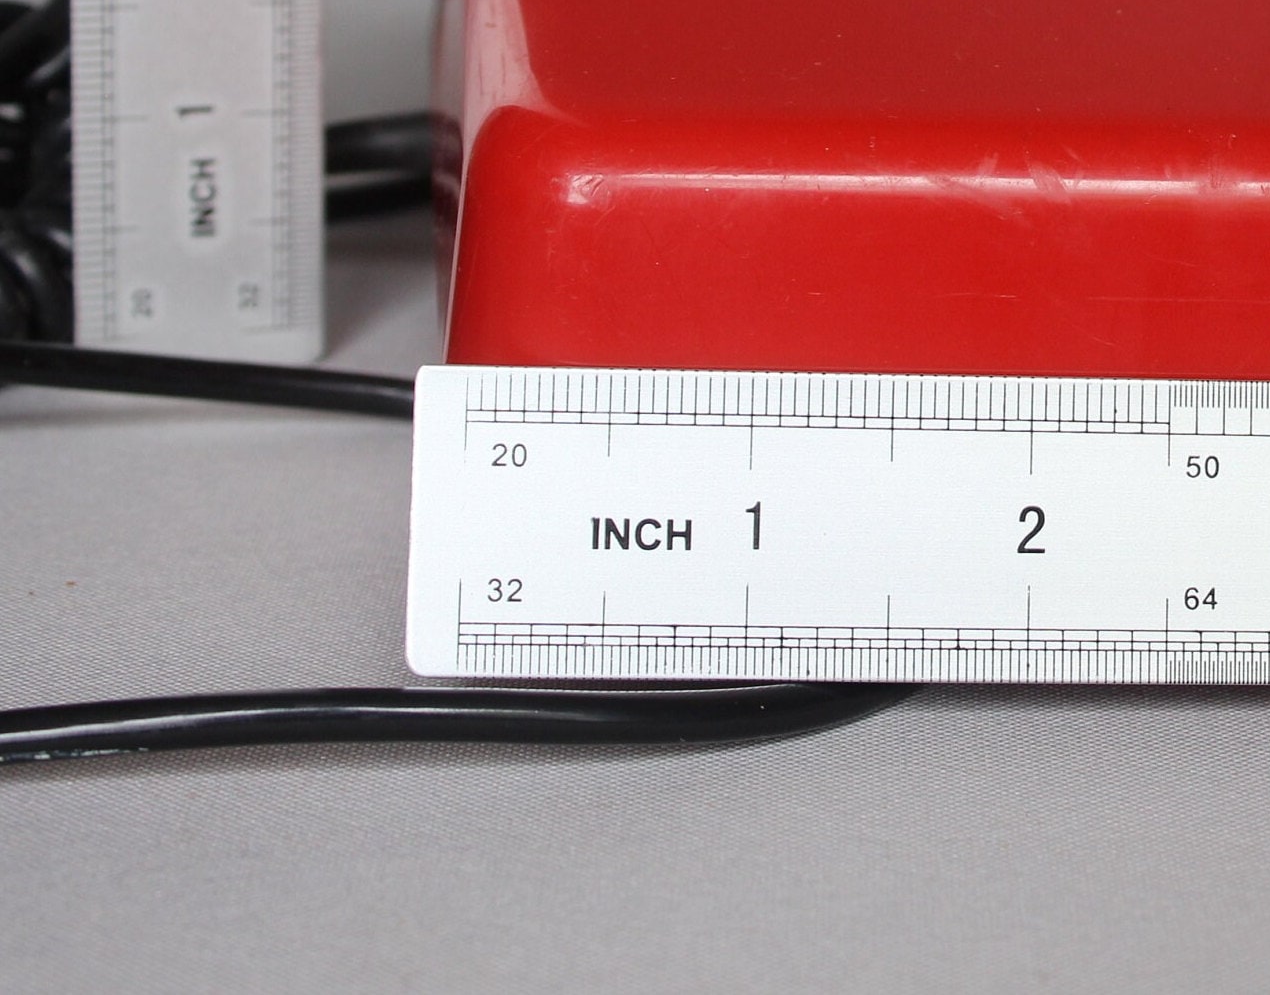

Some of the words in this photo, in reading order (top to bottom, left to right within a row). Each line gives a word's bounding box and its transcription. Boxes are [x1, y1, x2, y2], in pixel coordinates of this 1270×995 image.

[177, 104, 215, 117] 1
[190, 159, 217, 237] INCH
[491, 443, 528, 468] 20
[1186, 455, 1220, 479] 50
[591, 517, 693, 551] INCH
[745, 501, 762, 551] 1
[1016, 505, 1046, 554] 2
[487, 578, 523, 603] 32
[1184, 587, 1218, 611] 64
